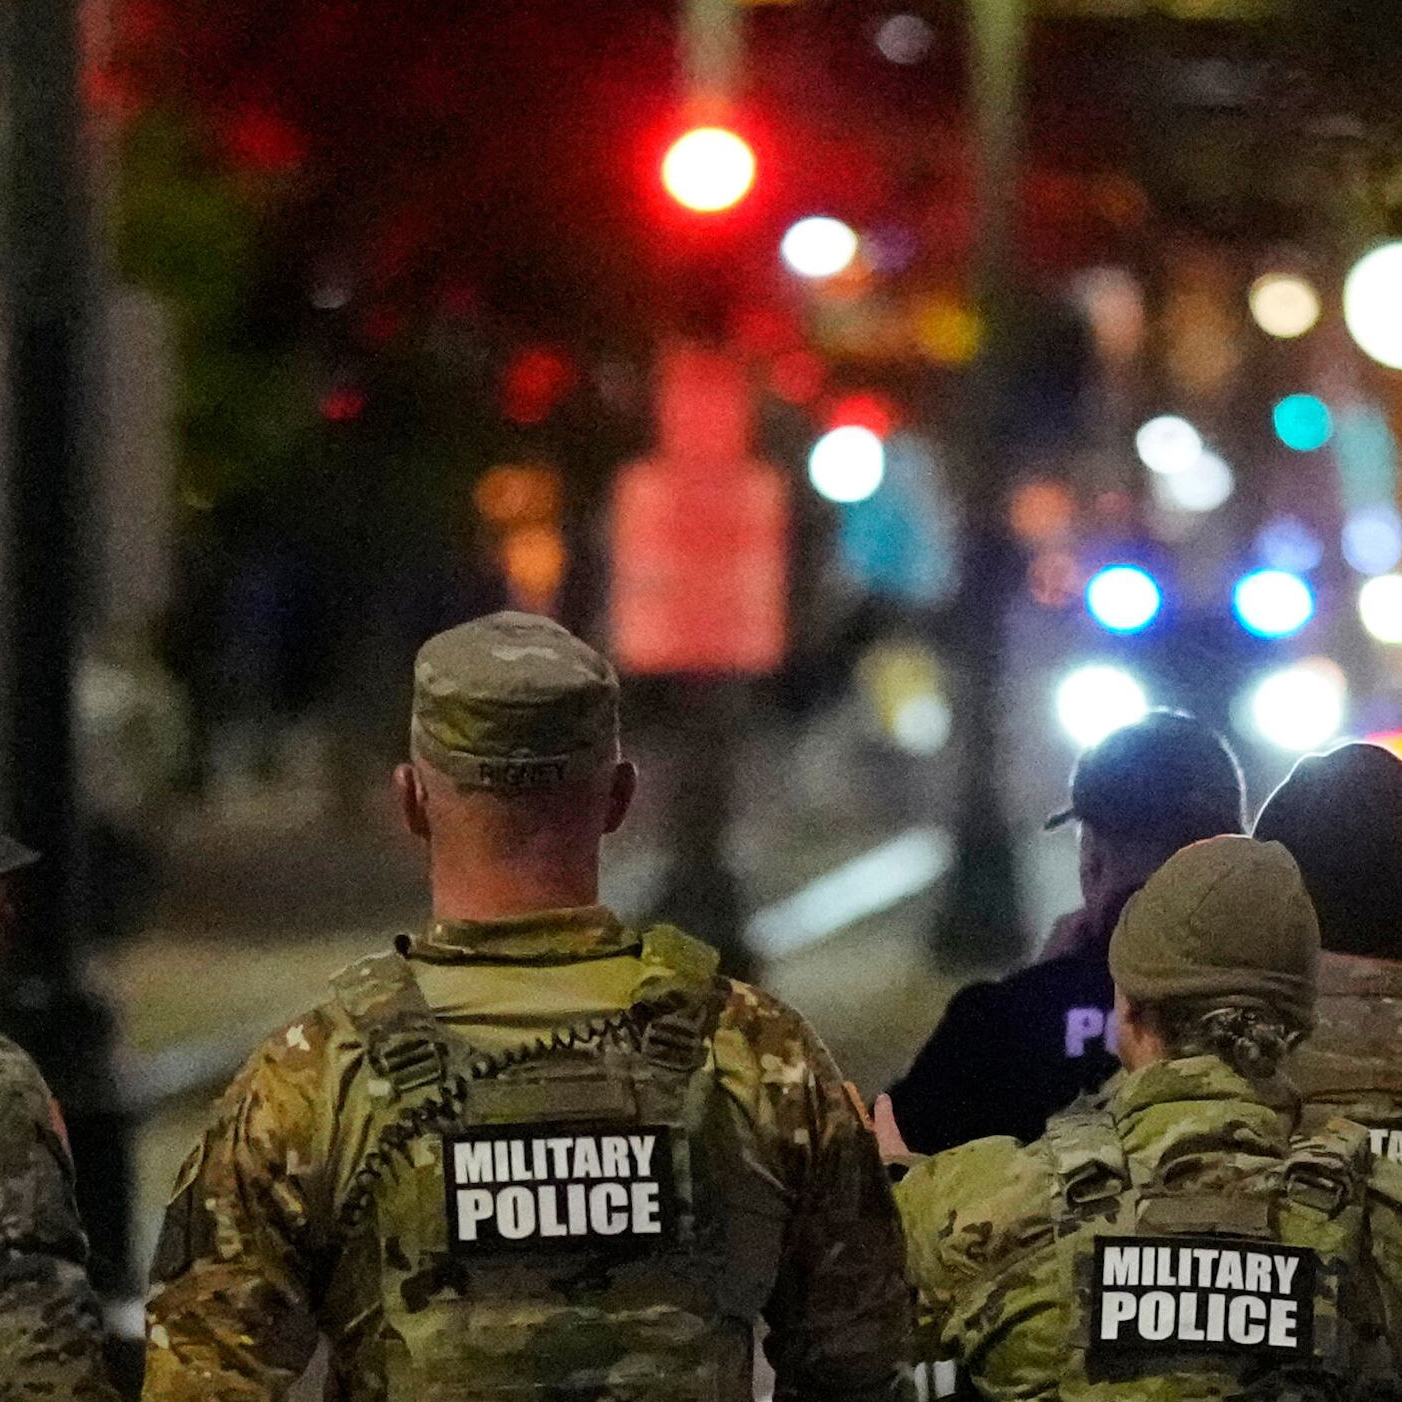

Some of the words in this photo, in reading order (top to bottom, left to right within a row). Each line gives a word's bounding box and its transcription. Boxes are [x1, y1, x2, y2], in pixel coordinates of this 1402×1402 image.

[454, 1135, 656, 1184] MILITARY
[457, 1182, 661, 1241] POLICE
[1103, 1246, 1299, 1295] MILITARY
[1101, 1290, 1298, 1348] POLICE
